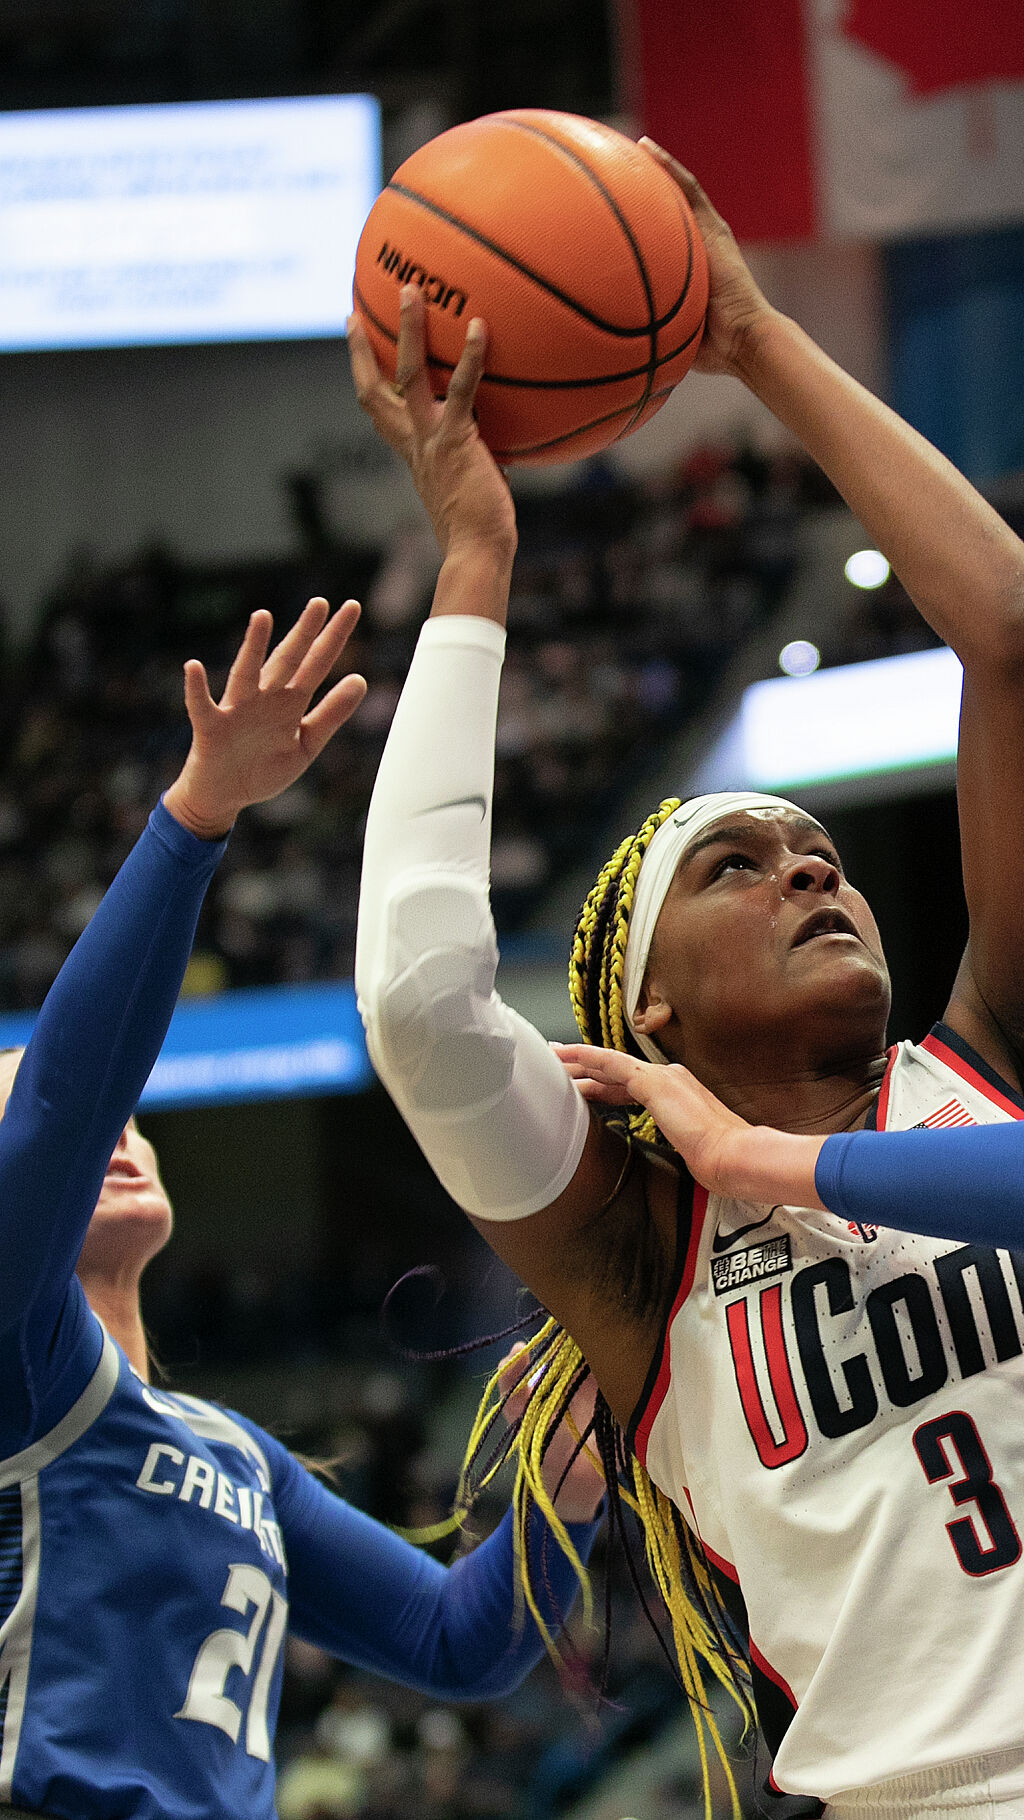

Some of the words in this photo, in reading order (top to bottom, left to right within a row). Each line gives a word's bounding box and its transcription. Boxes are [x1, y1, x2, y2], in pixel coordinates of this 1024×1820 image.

[716, 1255, 788, 1290] CHANGE
[912, 1410, 1023, 1577] 3
[173, 1564, 289, 1762] 21
